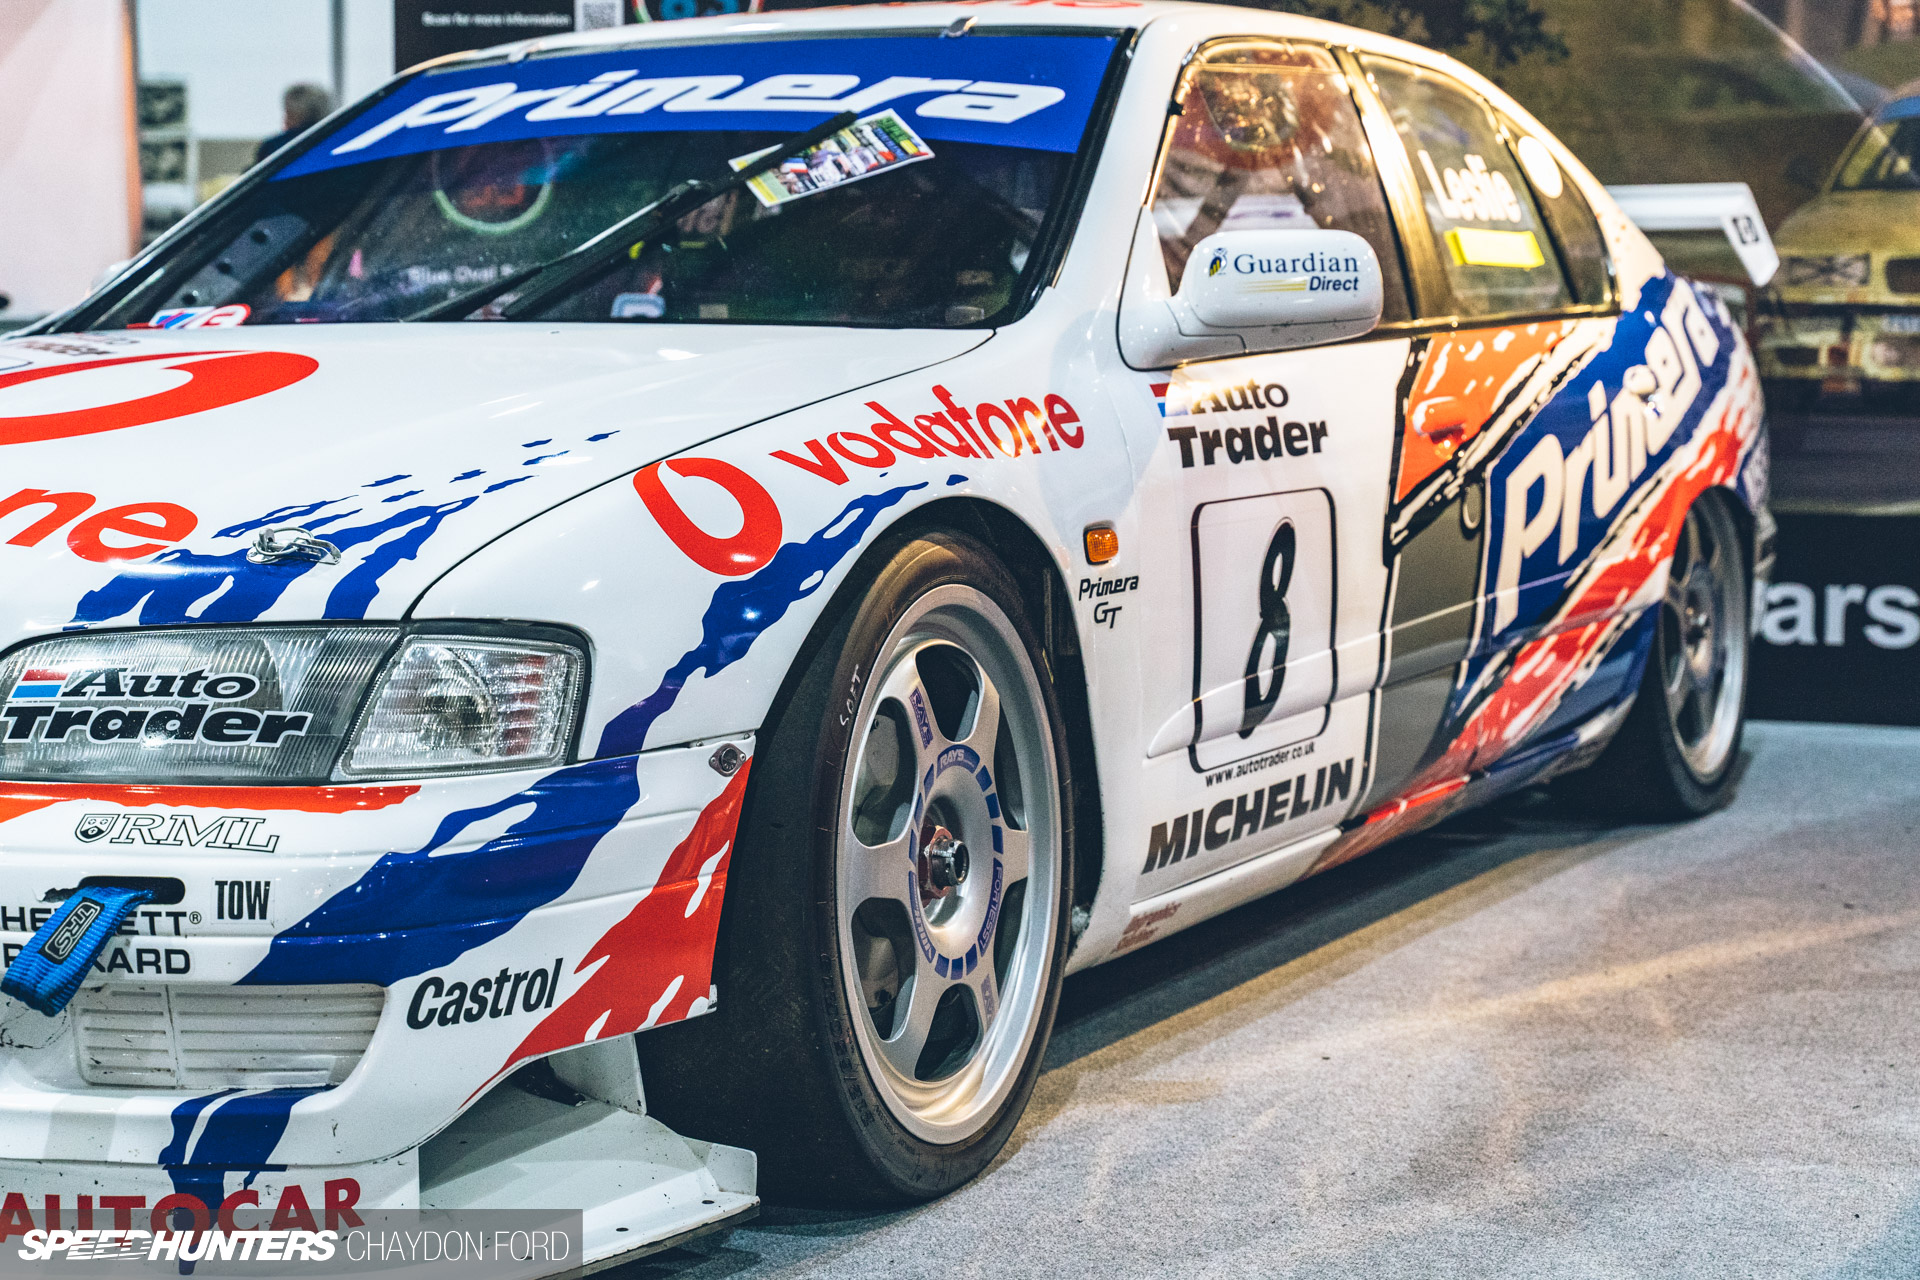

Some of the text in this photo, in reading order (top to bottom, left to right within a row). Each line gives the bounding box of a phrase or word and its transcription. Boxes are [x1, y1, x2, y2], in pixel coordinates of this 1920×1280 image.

[1233, 250, 1360, 275] Guardian
[1308, 275, 1359, 292] Direct
[769, 384, 1085, 486] vodafone
[1168, 416, 1329, 469] Trader
[1078, 575, 1139, 601] Primera
[1093, 601, 1123, 629] GT
[1239, 516, 1297, 741] 8
[59, 667, 259, 700] Auto
[839, 663, 862, 727] SOFT
[2, 702, 312, 746] Trader
[939, 748, 966, 770] RAYS
[1204, 741, 1316, 788] www.autotrader.co.uk
[110, 813, 279, 853] RML
[1140, 757, 1355, 876] MICHELIN
[214, 880, 272, 921] TOW
[54, 907, 95, 955] TRS
[406, 958, 564, 1030] Castrol
[0, 1177, 366, 1244] AUTOCAR
